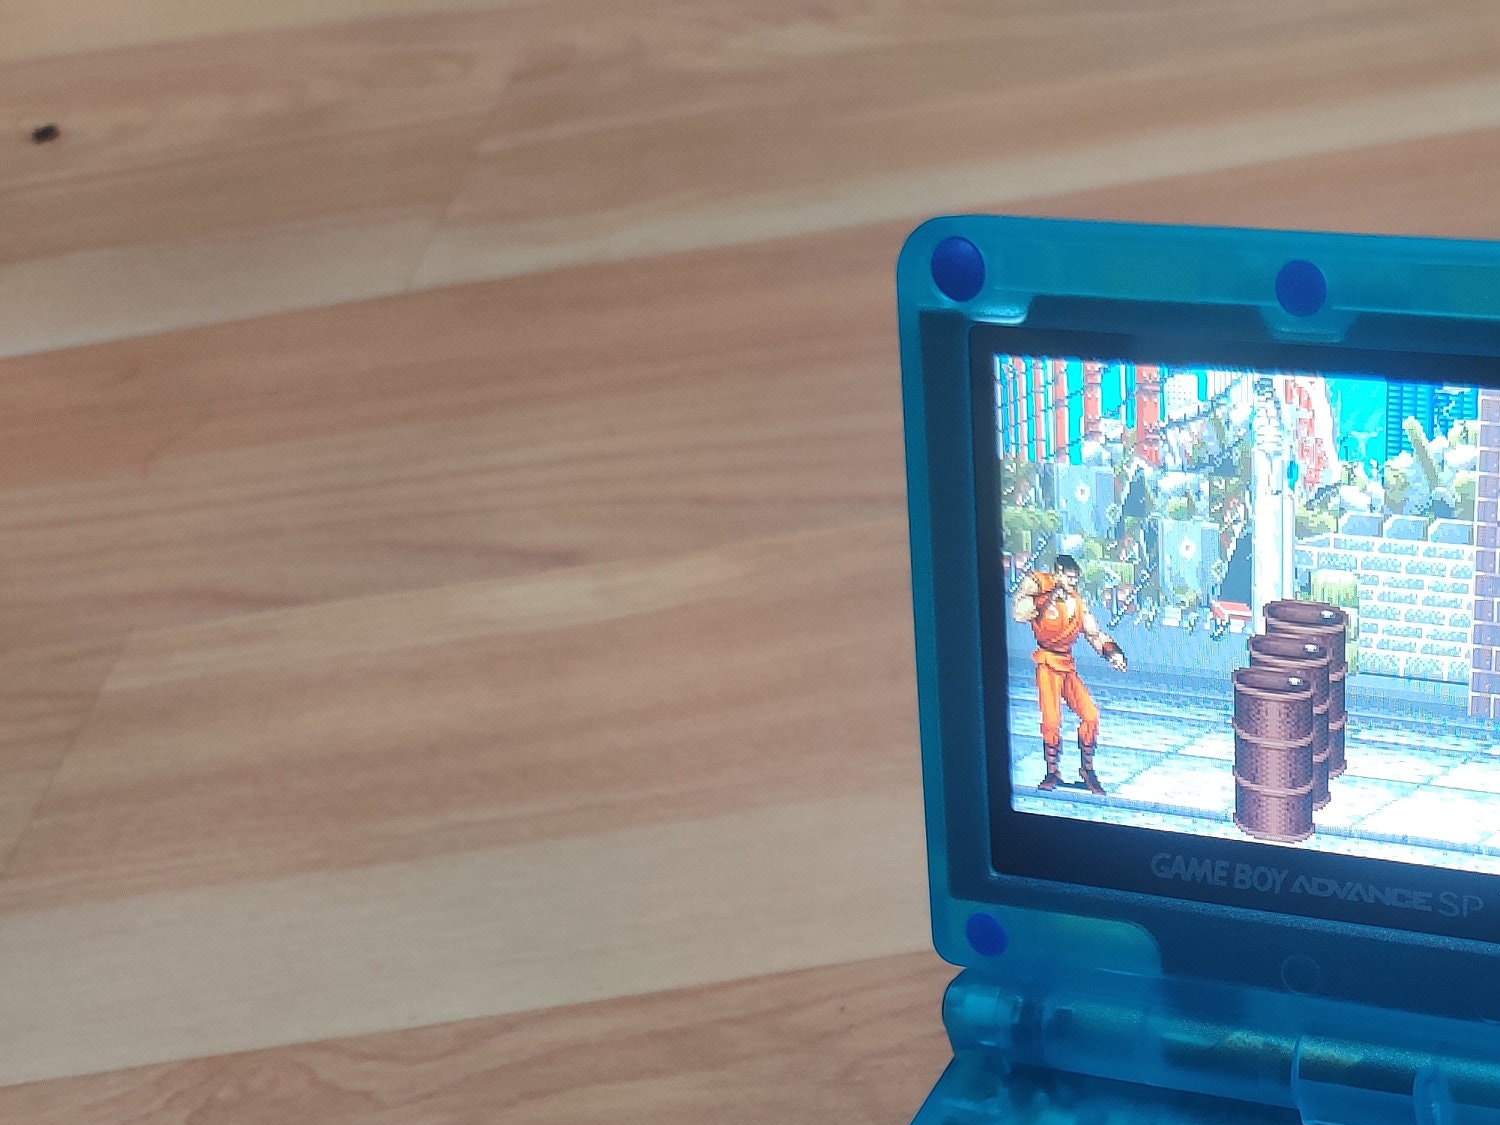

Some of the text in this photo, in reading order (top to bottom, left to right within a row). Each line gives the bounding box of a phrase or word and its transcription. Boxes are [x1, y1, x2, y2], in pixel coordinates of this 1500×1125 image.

[1150, 853, 1485, 918] GAME BOY ADVANCE SP
